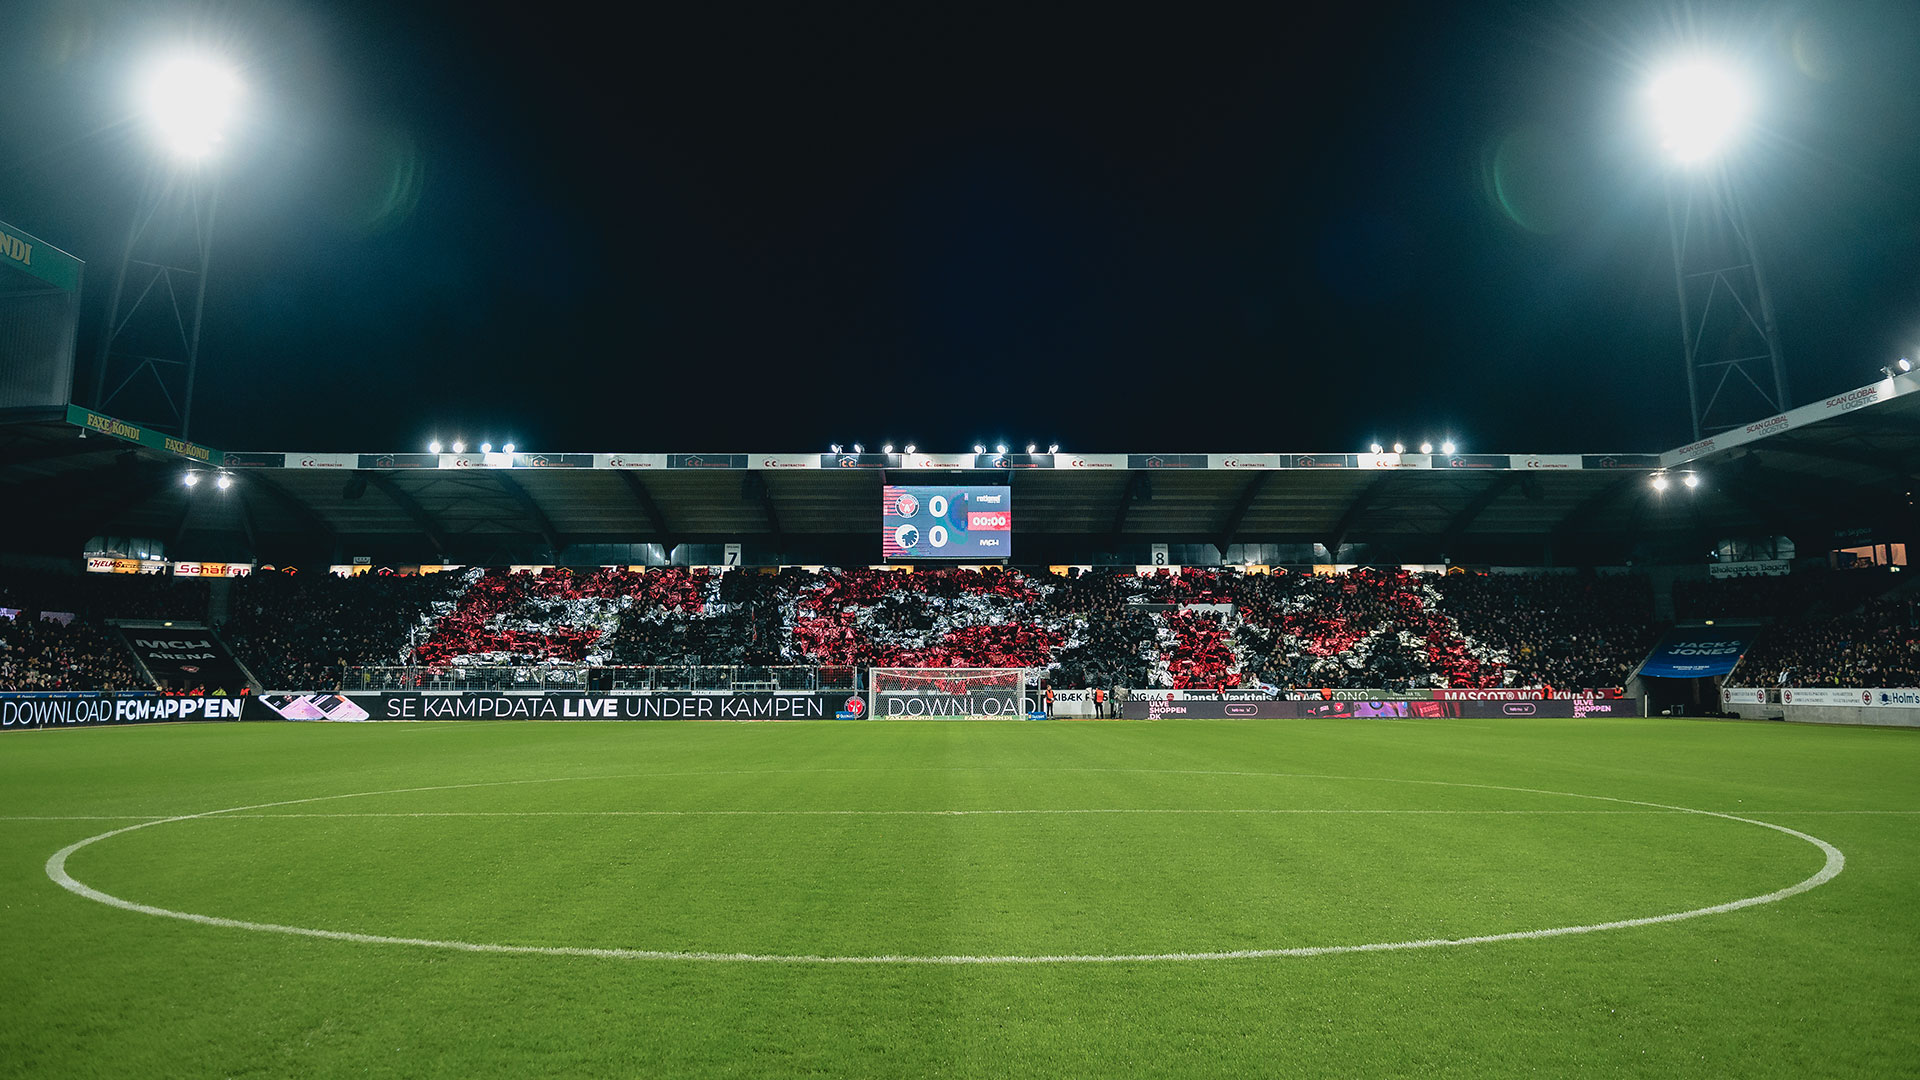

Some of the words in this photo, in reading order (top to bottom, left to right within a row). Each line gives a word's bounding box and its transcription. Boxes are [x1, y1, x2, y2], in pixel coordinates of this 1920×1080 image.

[1826, 396, 1846, 408] SCAN
[1848, 387, 1877, 401] GLOBAL
[1841, 394, 1878, 410] LOGISTICS
[87, 413, 111, 430] FAXE
[112, 421, 140, 440] KONDI
[1746, 424, 1763, 434] SCAN
[1764, 415, 1788, 428] GLOBAL
[1759, 422, 1789, 435] LOGISTICS
[165, 438, 185, 453] FAXE
[186, 444, 210, 460] KONDI
[929, 495, 948, 518] 0
[973, 516, 1006, 526] 00:00
[929, 525, 948, 548] 0
[979, 539, 999, 547] MCH
[728, 552, 738, 565] 7
[1156, 552, 1165, 565] 8
[136, 639, 212, 649] MCH
[1668, 646, 1738, 656] JONES
[149, 652, 216, 661] ARENA
[1184, 692, 1219, 701] Dansk
[3, 700, 113, 725] DOWNLOAD
[387, 698, 416, 717] SE
[424, 698, 558, 717] KAMPDATA
[563, 698, 618, 717] LIVE
[626, 698, 713, 717] UNDER
[720, 698, 823, 717] KAMPEN
